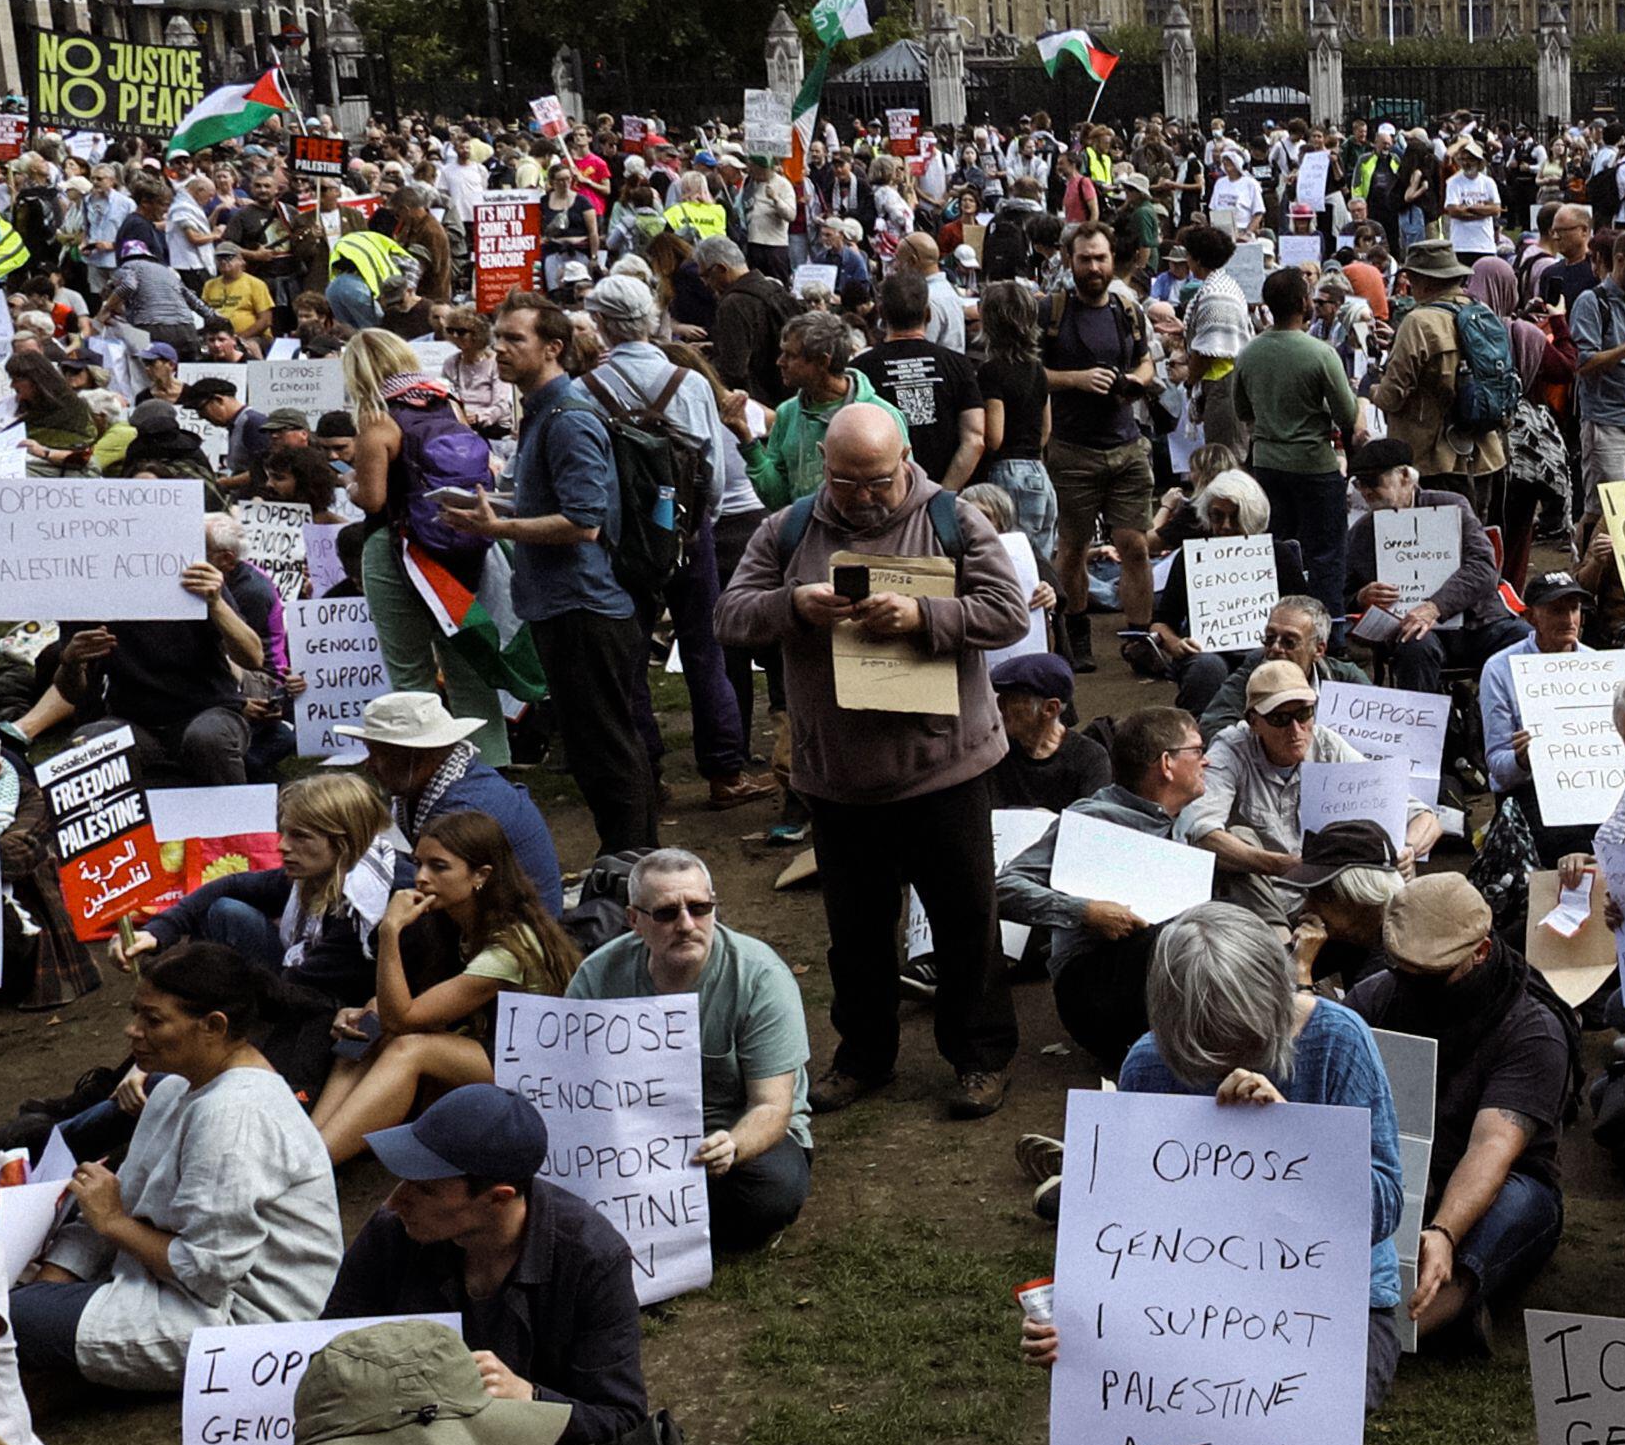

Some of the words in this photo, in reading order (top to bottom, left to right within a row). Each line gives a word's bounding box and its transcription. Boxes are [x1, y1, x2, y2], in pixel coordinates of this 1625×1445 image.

[38, 32, 102, 76] NO
[108, 43, 204, 90] JUSTICE
[40, 73, 106, 118] NO
[296, 137, 343, 163] FREE
[295, 159, 342, 173] PALESTINE
[478, 206, 494, 222] IT'S
[497, 206, 516, 221] NOT
[478, 221, 507, 237] CRIME
[509, 221, 523, 236] TO
[479, 236, 498, 253] ACT
[499, 235, 536, 252] AGAINST
[479, 252, 525, 269] GENOCIDE
[279, 367, 323, 378] OPPOSE
[271, 382, 321, 392] GENOCIDE
[0, 487, 84, 515] OPPOSE
[95, 487, 182, 506] GENOCIDE
[37, 518, 139, 541] SUPPORT
[113, 551, 198, 580] ACTION
[1214, 545, 1272, 559] OPPOSE
[1193, 569, 1273, 589] GENOCIDE
[1218, 592, 1275, 613] SUPPORT
[1545, 660, 1614, 673] OPPOSE
[1350, 698, 1436, 727] OPPOSE
[51, 754, 132, 815] FREEDOM
[57, 793, 146, 858] PALESTINE
[80, 840, 138, 880] الحرية
[82, 861, 152, 919] لفلسطين
[537, 1011, 688, 1054] OPPOSE
[1152, 1140, 1309, 1185] OPPOSE
[1096, 1226, 1329, 1279] GENOCIDE
[1147, 1304, 1331, 1345] SUPPORT
[1101, 1368, 1309, 1416] PALESTINE
